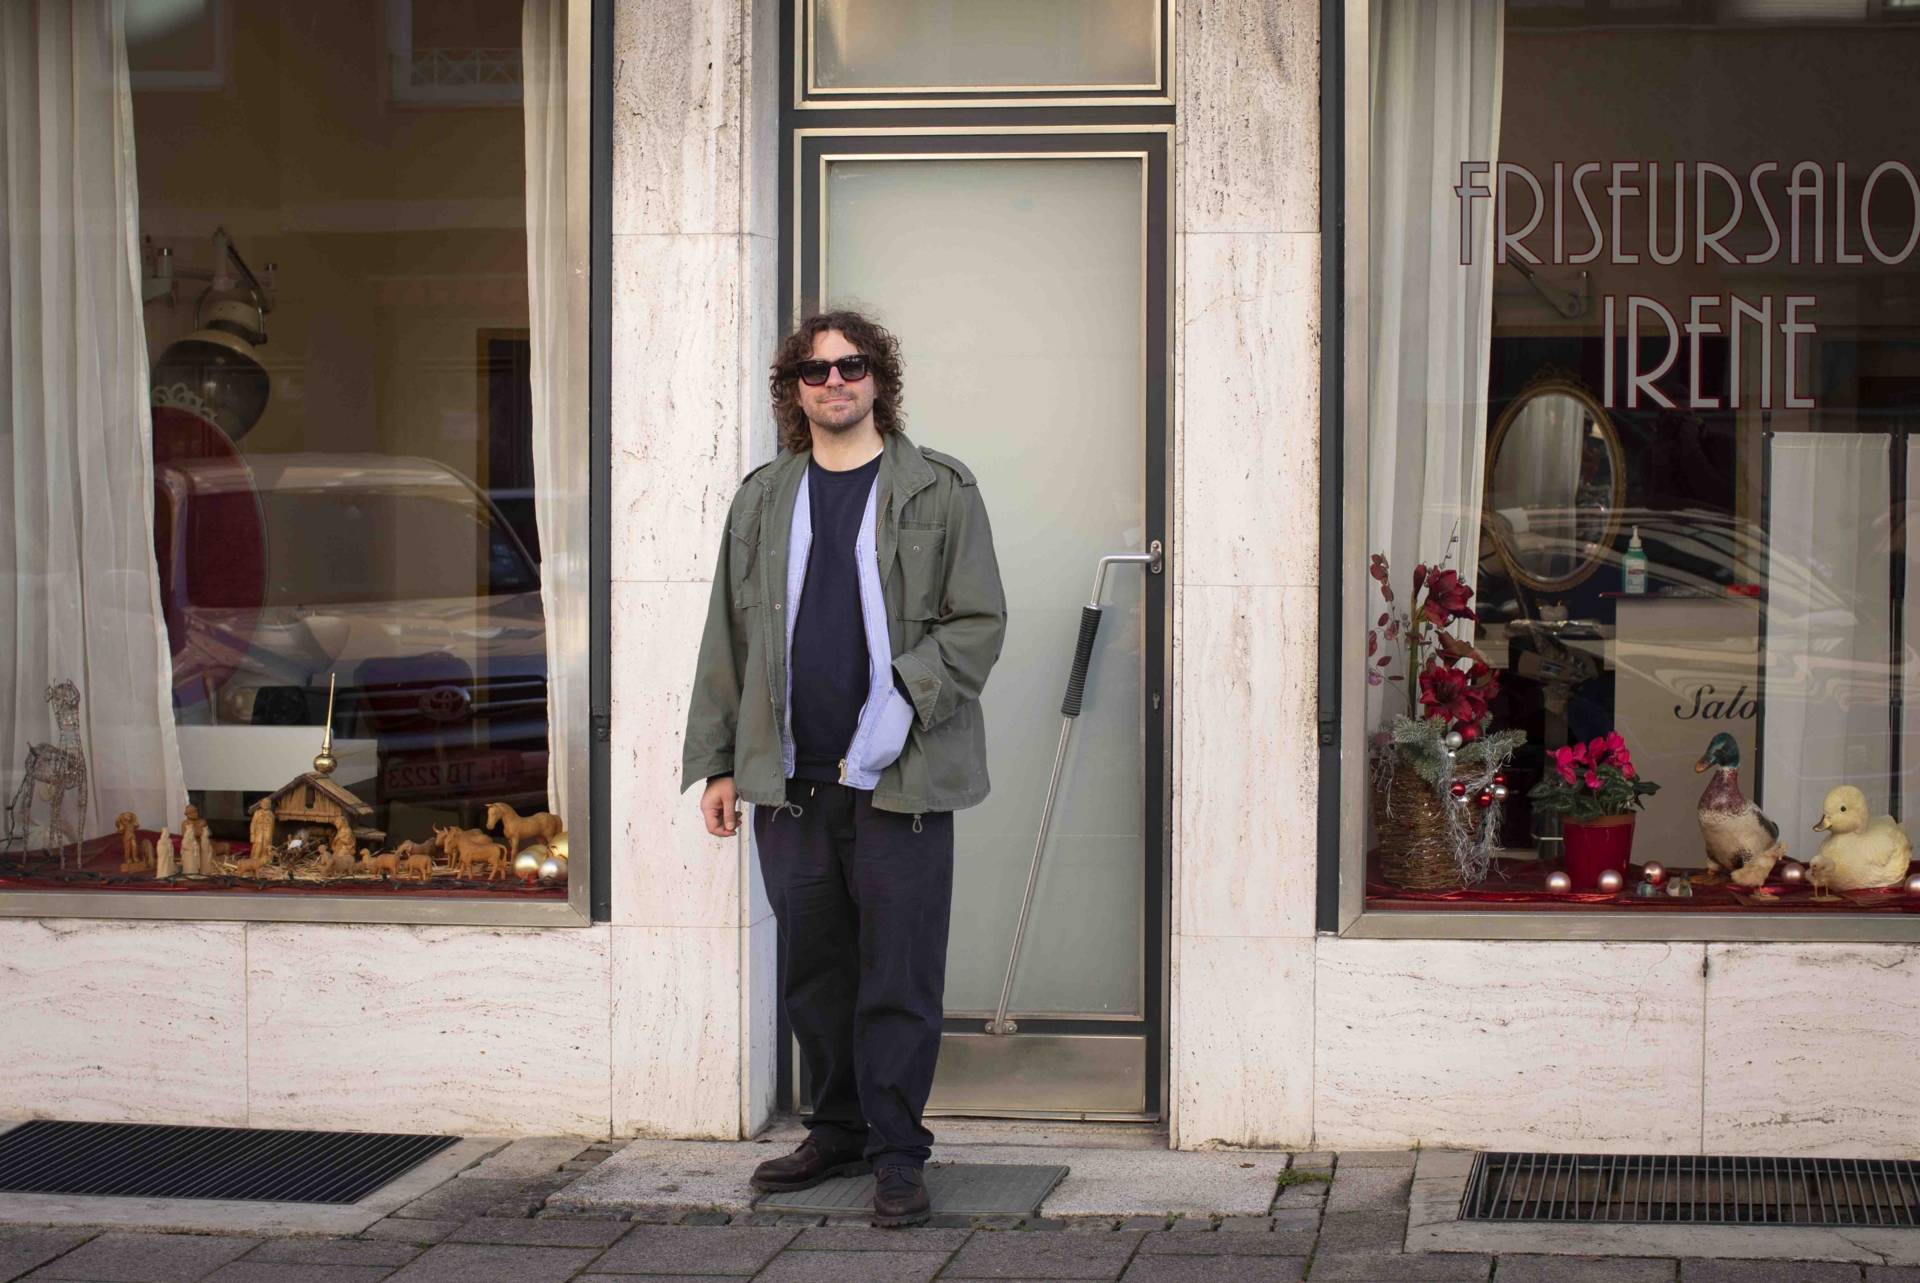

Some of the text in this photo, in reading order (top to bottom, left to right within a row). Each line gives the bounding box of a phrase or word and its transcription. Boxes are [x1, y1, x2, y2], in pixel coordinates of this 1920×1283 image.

[1454, 161, 1920, 265] FRISEURSALO
[1603, 294, 1817, 410] IRENE
[1674, 684, 1758, 720] Salo
